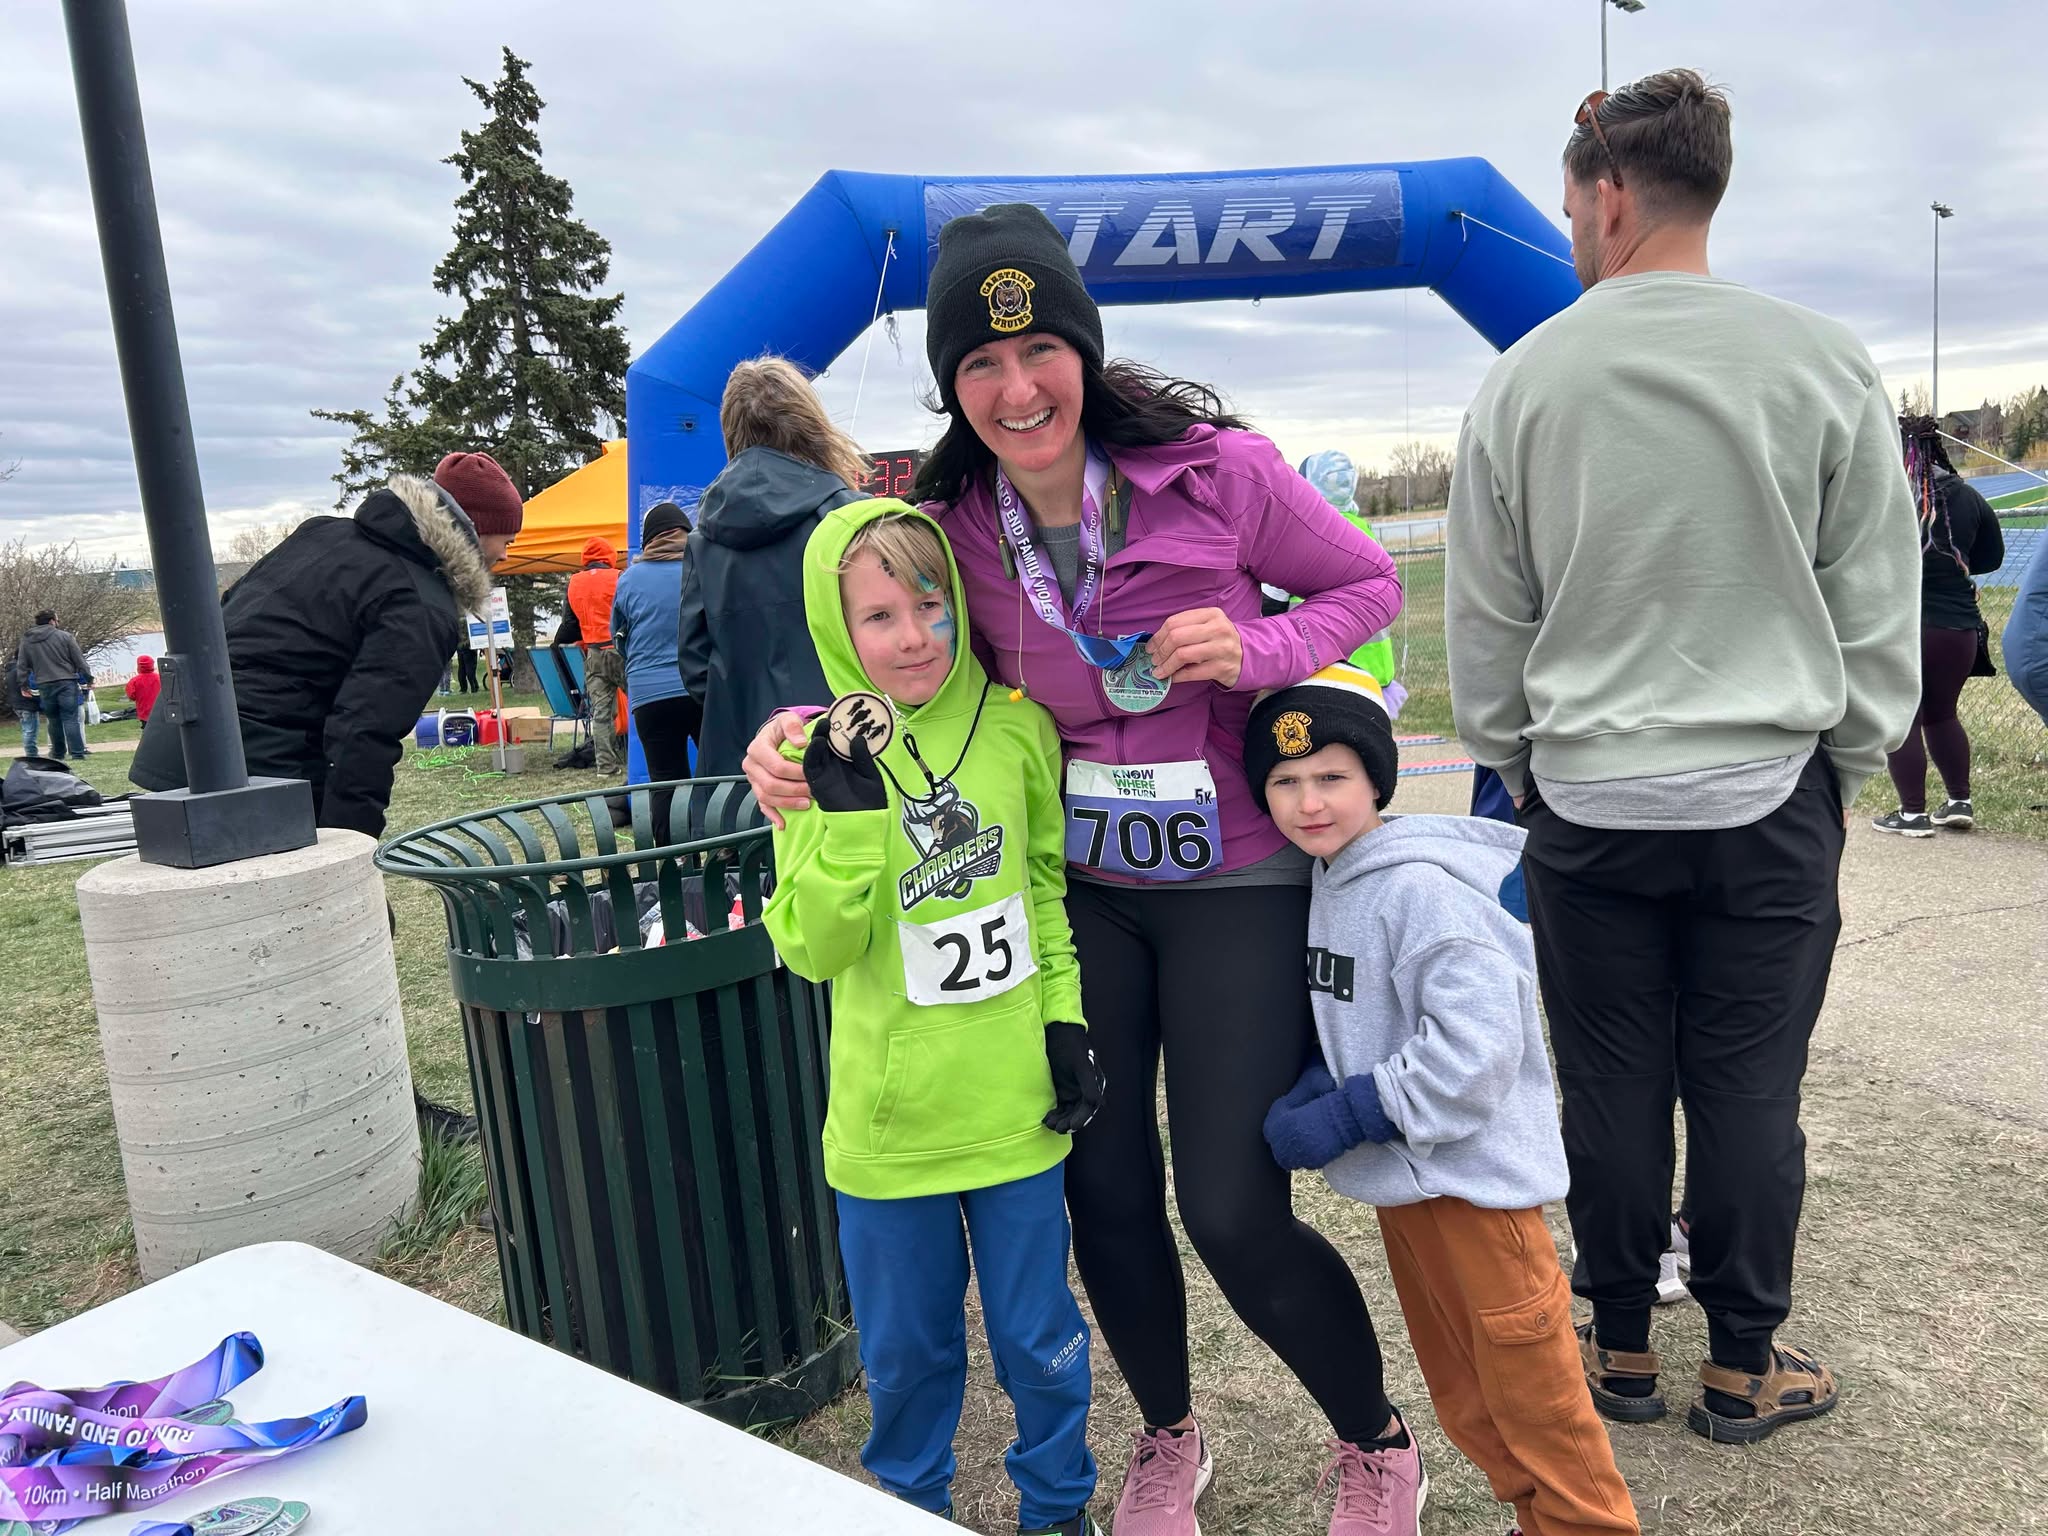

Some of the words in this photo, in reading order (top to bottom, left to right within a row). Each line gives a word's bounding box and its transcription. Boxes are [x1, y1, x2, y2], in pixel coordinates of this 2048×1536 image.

[977, 194, 1374, 267] TART
[982, 271, 1034, 294] CARSTAIRS
[994, 313, 1031, 329] BRUINS
[1001, 488, 1012, 507] TO
[1006, 508, 1025, 536] END
[1087, 511, 1099, 564] Marathon
[1017, 536, 1044, 579] FAMILY
[1084, 565, 1096, 589] Half
[1296, 616, 1320, 671] LULULEMON
[1112, 769, 1154, 780] KNOW
[1115, 778, 1156, 789] WHERE
[1117, 787, 1131, 796] TO
[1132, 788, 1157, 798] TURN
[1072, 806, 1213, 872] 706
[902, 829, 1000, 907] CHARGERS
[933, 915, 1012, 991] 25
[1051, 1332, 1084, 1367] OUTDOOR
[8, 1406, 77, 1436] FAMILY
[80, 1422, 120, 1447] END
[152, 1424, 195, 1443] RUN
[126, 1426, 152, 1447] TO
[24, 1484, 67, 1505] 10km
[86, 1482, 123, 1501] Half
[127, 1465, 206, 1501] Marathon
